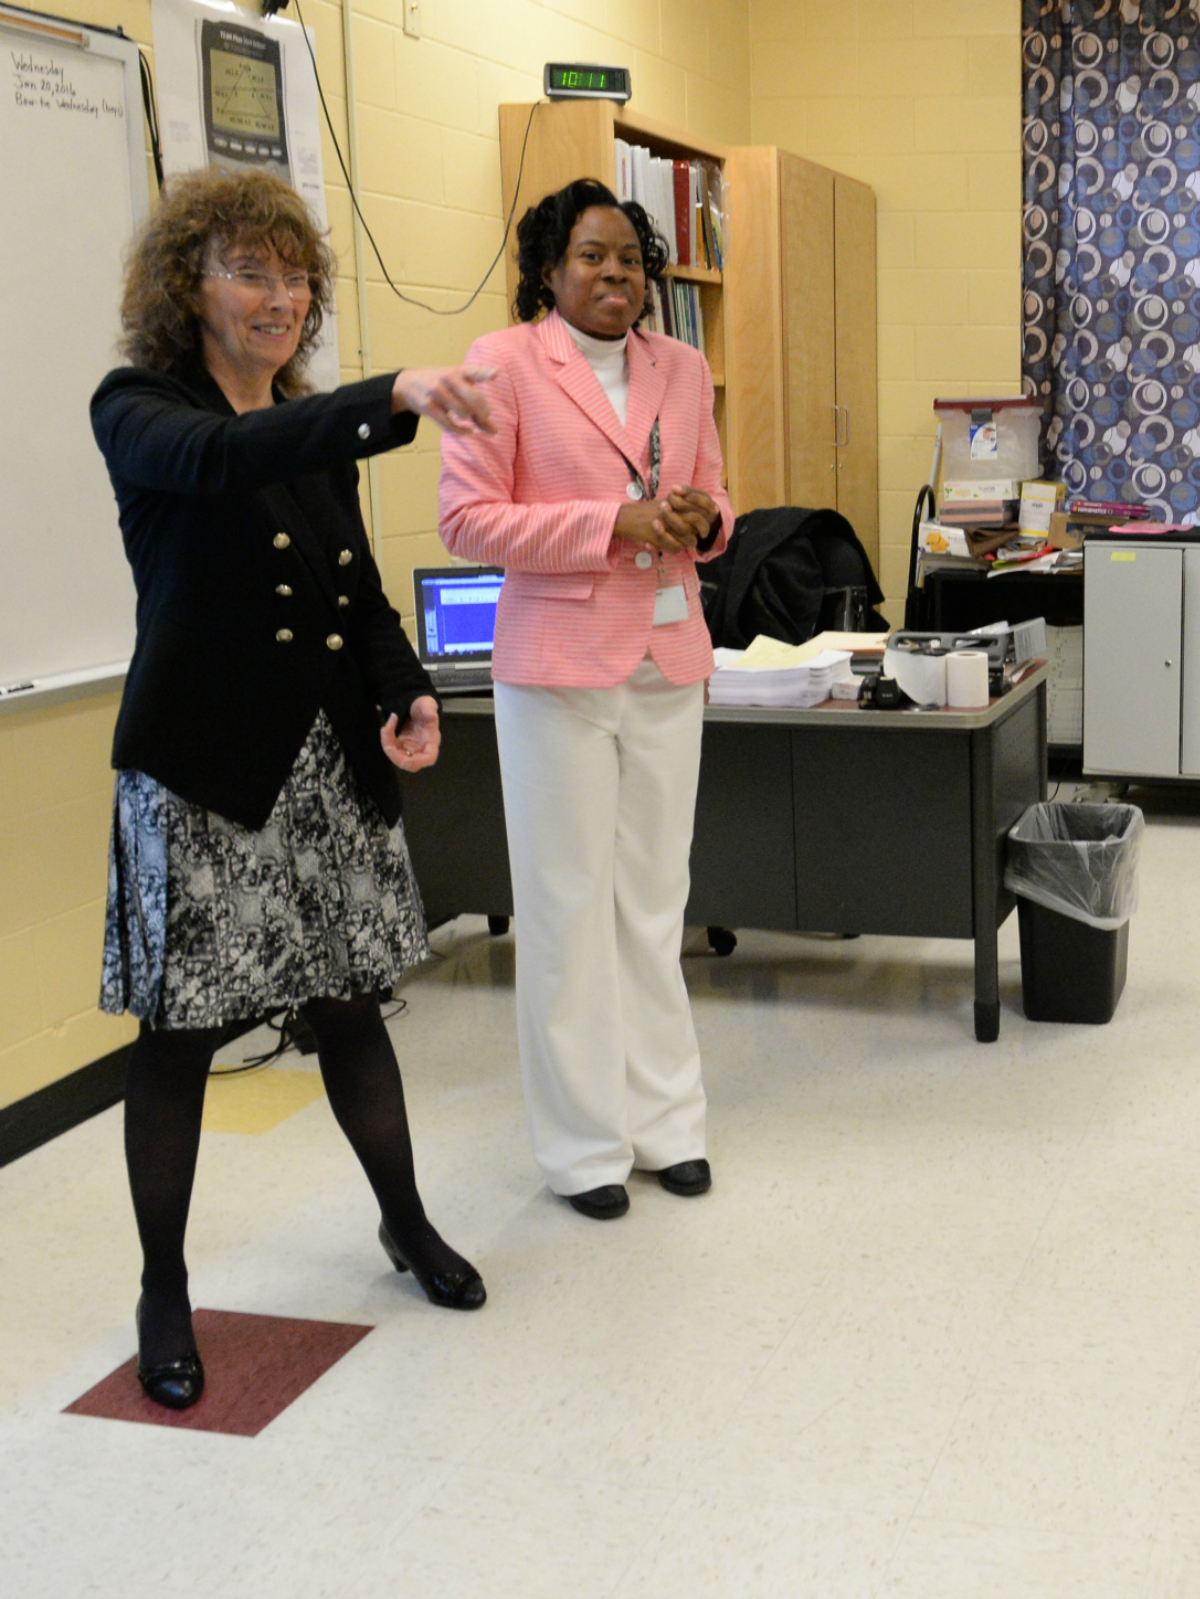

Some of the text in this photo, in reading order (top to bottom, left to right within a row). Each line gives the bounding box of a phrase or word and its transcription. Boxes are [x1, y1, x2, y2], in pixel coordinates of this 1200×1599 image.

[11, 50, 64, 83] Wednesday
[13, 73, 36, 90] Jan
[57, 97, 98, 119] Wednesday
